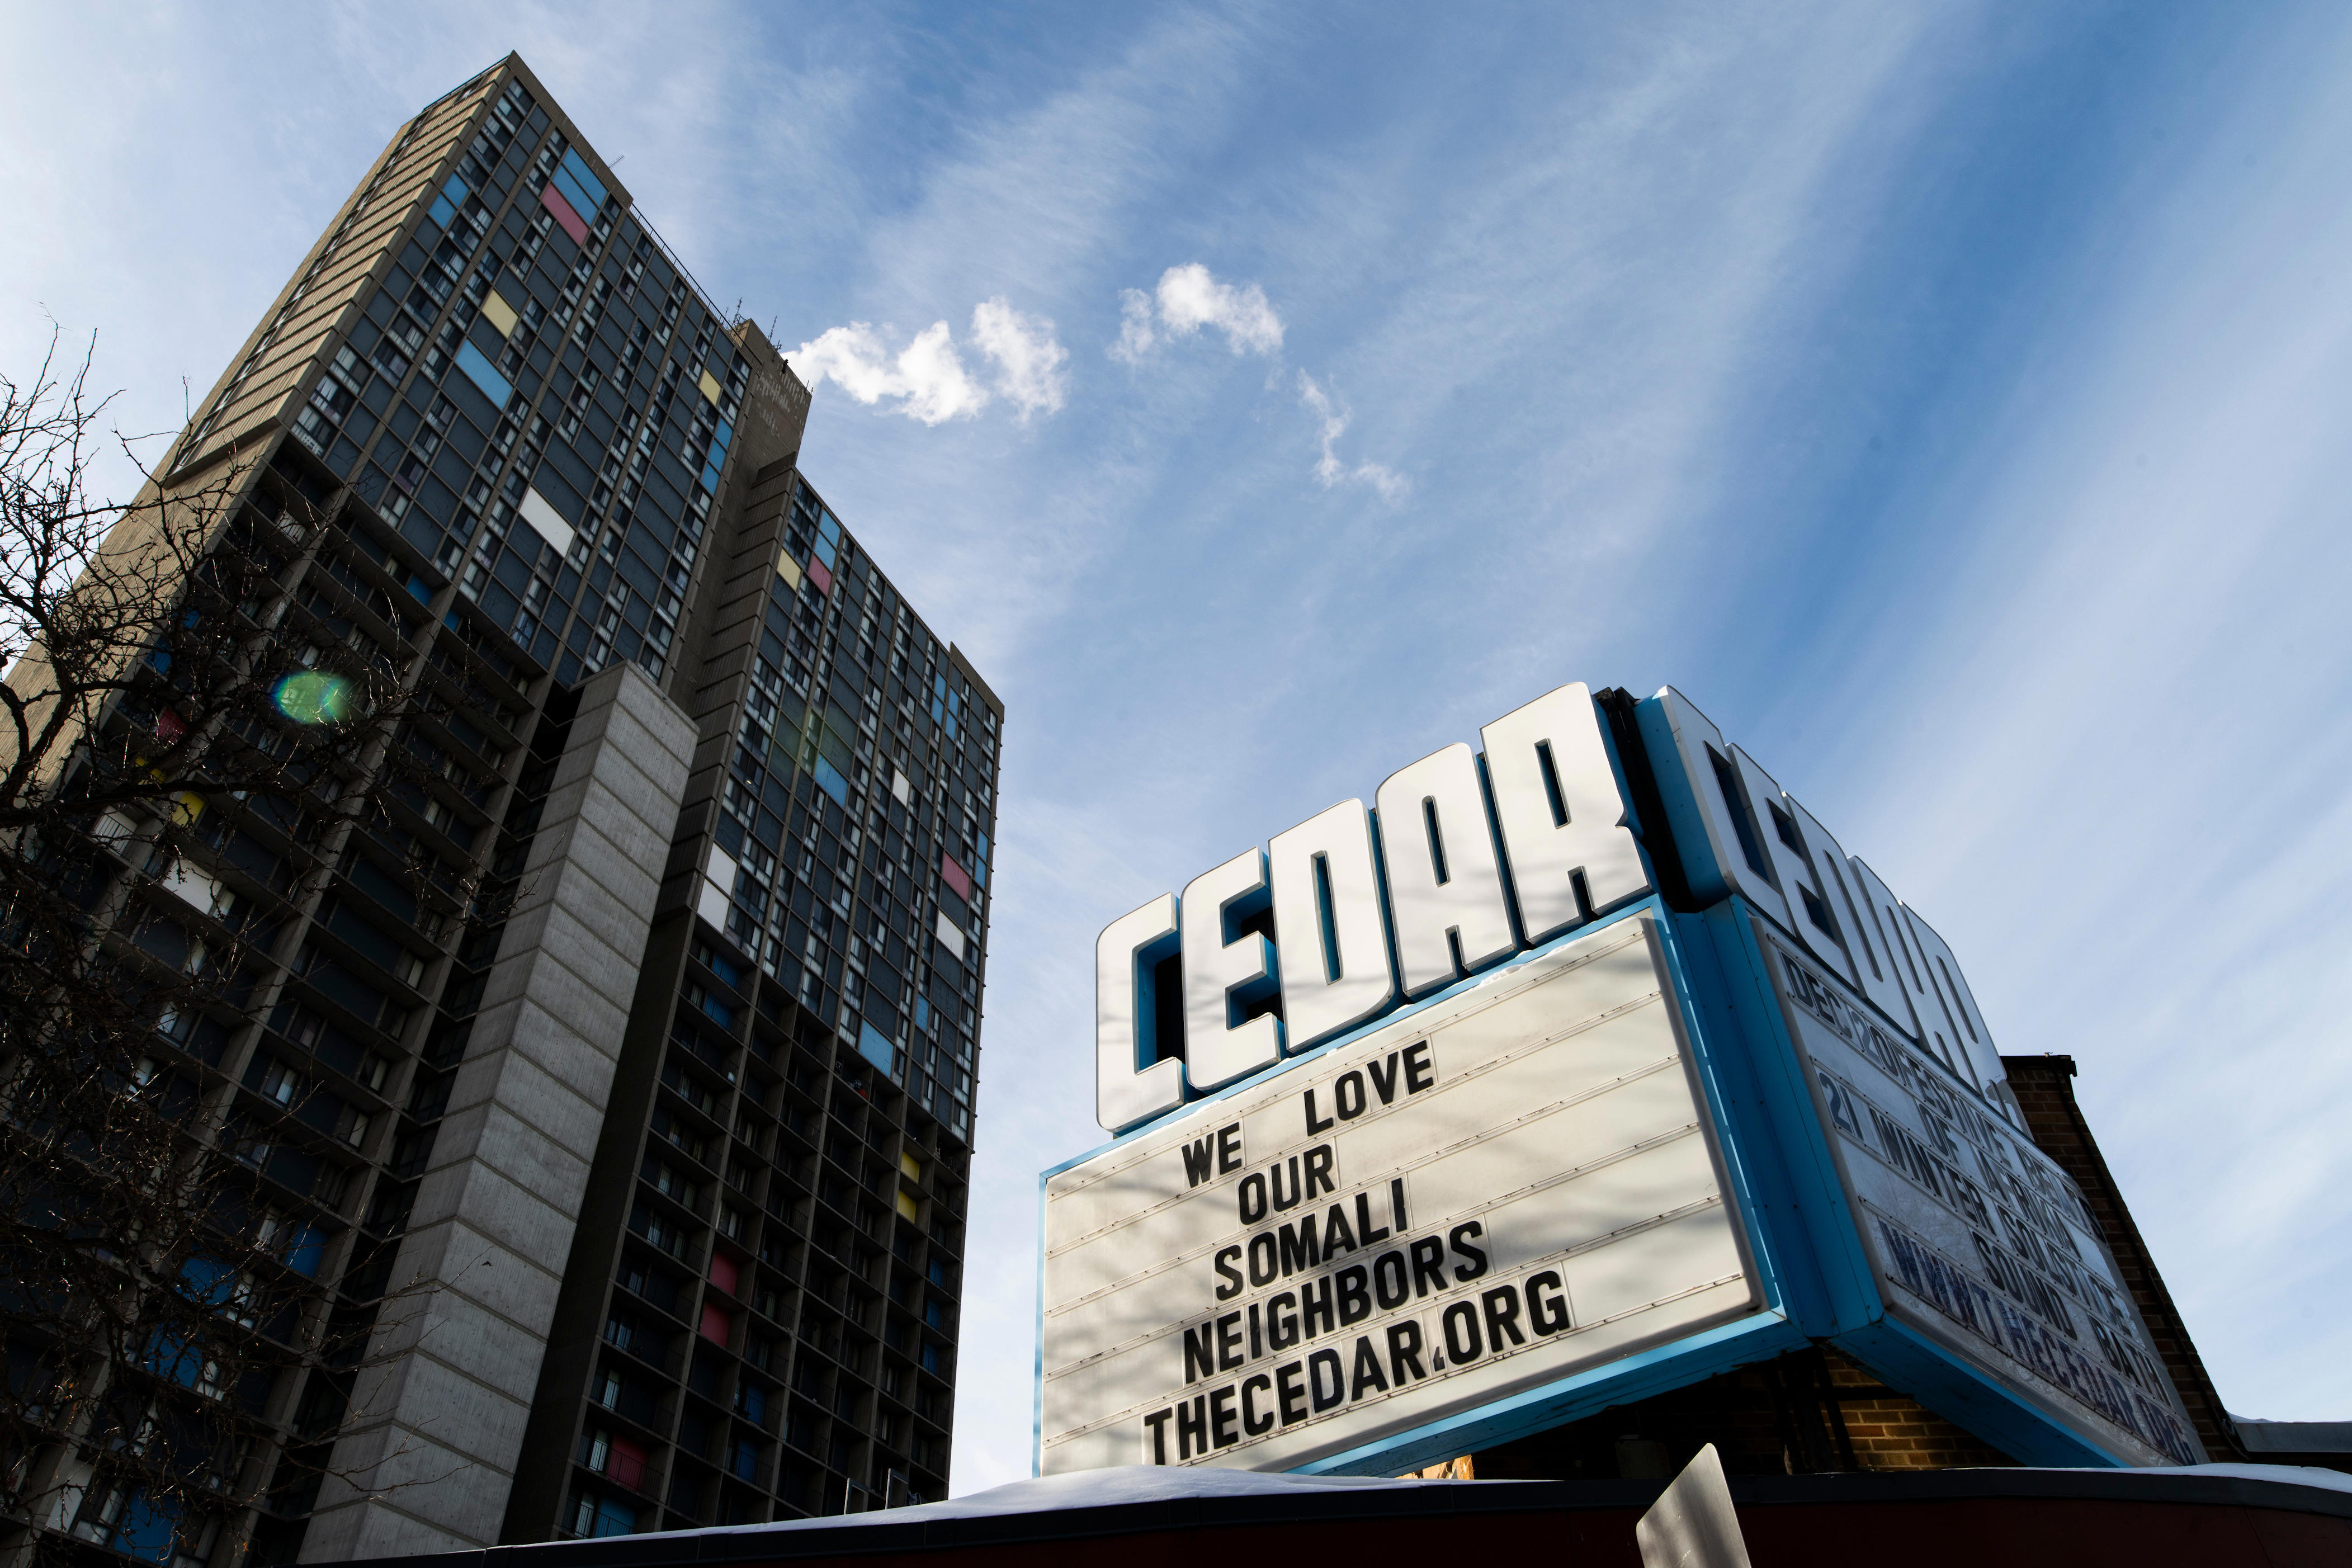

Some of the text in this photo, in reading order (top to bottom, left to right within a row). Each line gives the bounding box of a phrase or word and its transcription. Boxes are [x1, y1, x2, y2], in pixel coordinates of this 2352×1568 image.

[1096, 682, 1651, 1130] CEDAR
[1662, 685, 2034, 1142] CEDAR
[1780, 951, 1855, 1042] DEC
[1182, 1040, 1434, 1188] WE LOVE
[1238, 1144, 1335, 1225] OUR
[1918, 1103, 2082, 1259] OF AFRIKA
[1215, 1178, 1409, 1301] SOMALI
[1817, 1071, 2133, 1338] 21 WINTER SOLSTICE
[1184, 1219, 1487, 1384] NEIGHBORS
[1972, 1232, 2171, 1406] SOUND BATH
